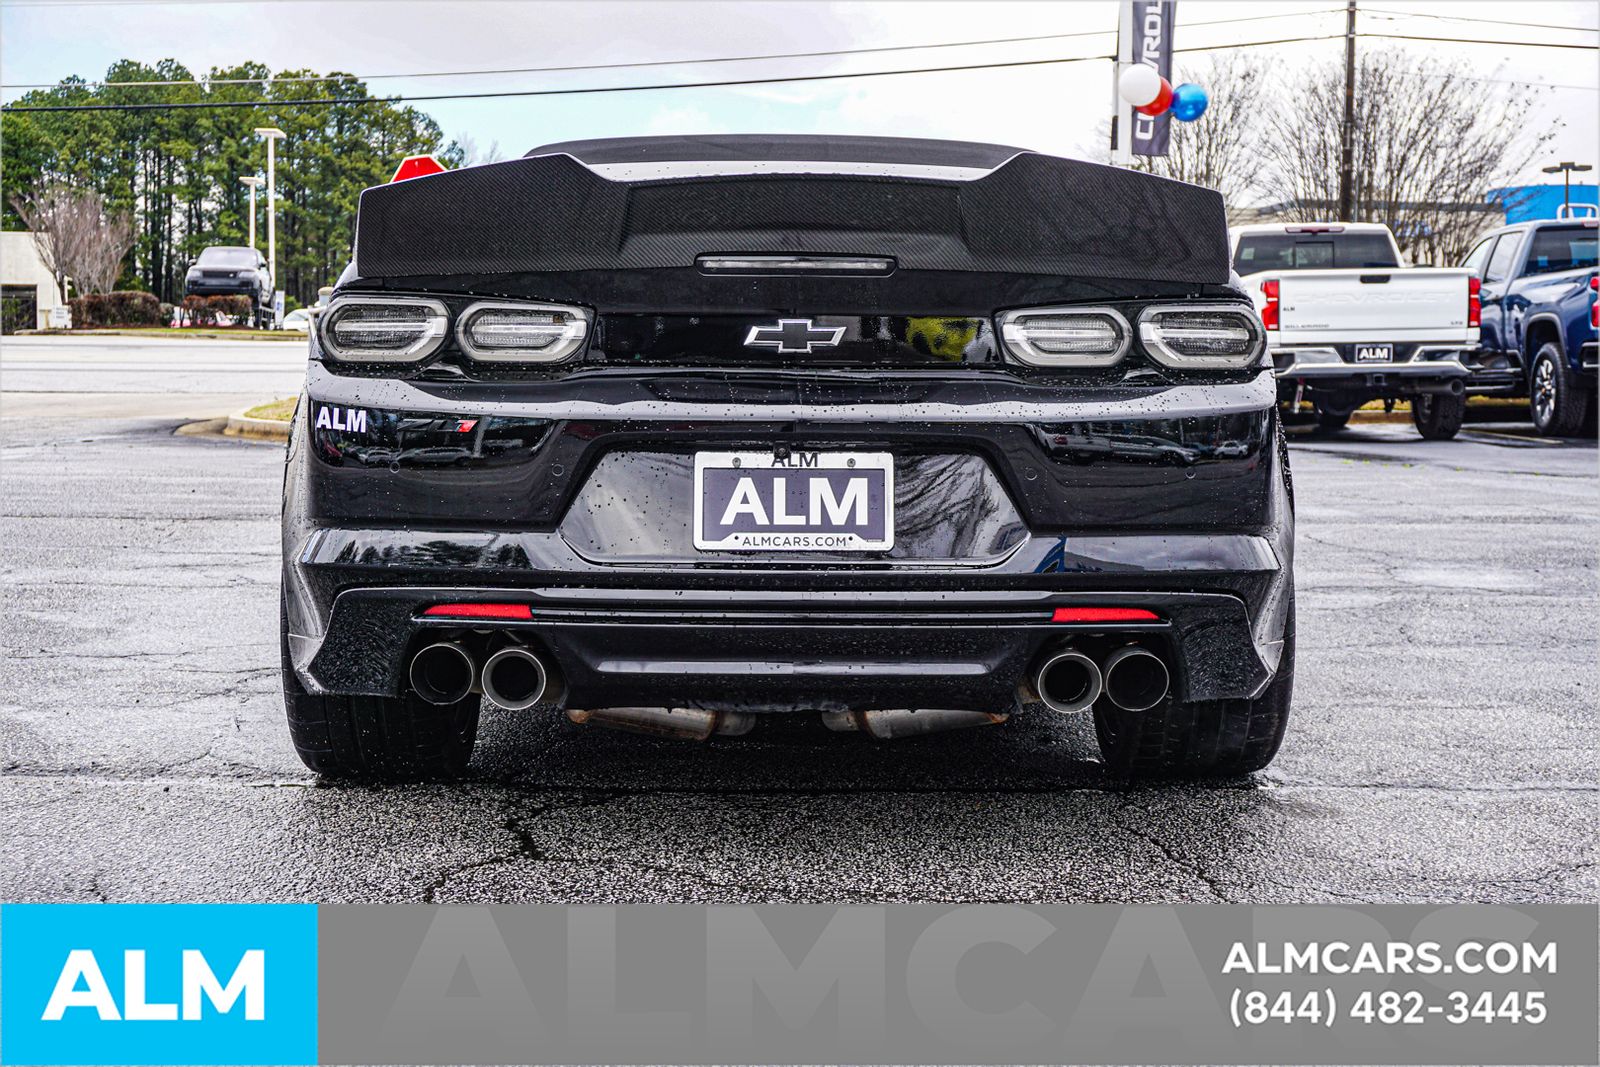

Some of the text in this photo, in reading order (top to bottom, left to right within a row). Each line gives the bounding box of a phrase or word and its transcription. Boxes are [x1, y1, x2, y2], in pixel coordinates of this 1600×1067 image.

[1359, 348, 1388, 359] ALM
[316, 406, 367, 433] ALM
[771, 453, 818, 467] ALM
[720, 477, 869, 526] ALM
[742, 536, 847, 547] ALMCARS.COM
